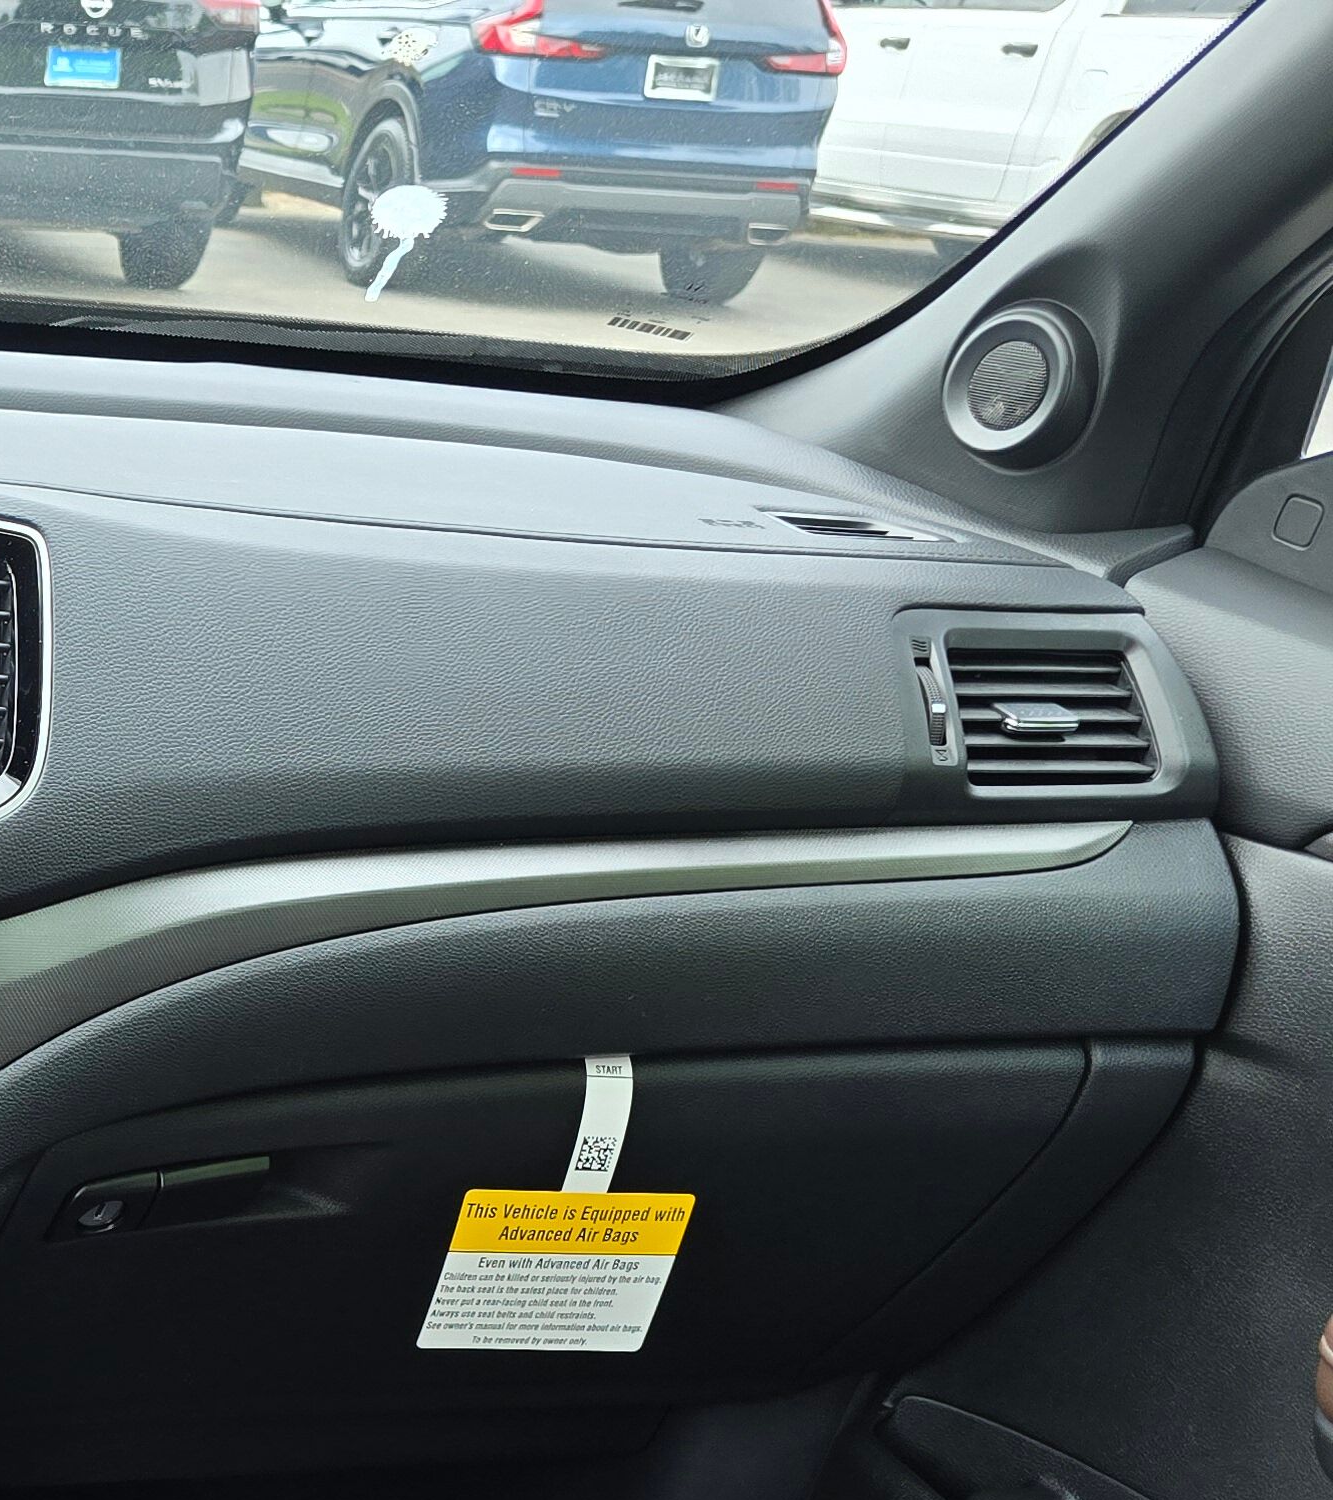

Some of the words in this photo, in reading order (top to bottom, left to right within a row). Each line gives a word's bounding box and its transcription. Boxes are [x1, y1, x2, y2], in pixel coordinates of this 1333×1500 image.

[41, 22, 149, 40] ROGUE
[596, 1064, 622, 1075] START
[467, 1203, 497, 1219] This
[503, 1204, 557, 1220] Vehicle
[563, 1206, 576, 1220] is
[582, 1206, 650, 1224] Equipped
[654, 1207, 685, 1222] with
[498, 1226, 571, 1242] Advanced
[575, 1227, 598, 1242] Air
[602, 1228, 639, 1245] Bags
[478, 1257, 505, 1268] Even
[509, 1258, 532, 1268] with
[535, 1258, 591, 1269] Advanced
[592, 1259, 609, 1270] Air
[612, 1259, 640, 1272] Bags
[444, 1272, 477, 1281] Children
[495, 1273, 505, 1281] be
[508, 1273, 529, 1282] killed
[541, 1274, 577, 1284] seriously
[578, 1274, 606, 1284] injured
[607, 1275, 617, 1284] by
[619, 1275, 630, 1283] the
[633, 1275, 644, 1283] air
[645, 1276, 661, 1285] bag.
[440, 1284, 455, 1293] The
[456, 1285, 474, 1293] back
[496, 1286, 504, 1294] is
[506, 1286, 519, 1294] the
[520, 1286, 545, 1294] safest
[546, 1287, 568, 1296] place
[570, 1287, 582, 1295] for
[583, 1287, 618, 1295] children.
